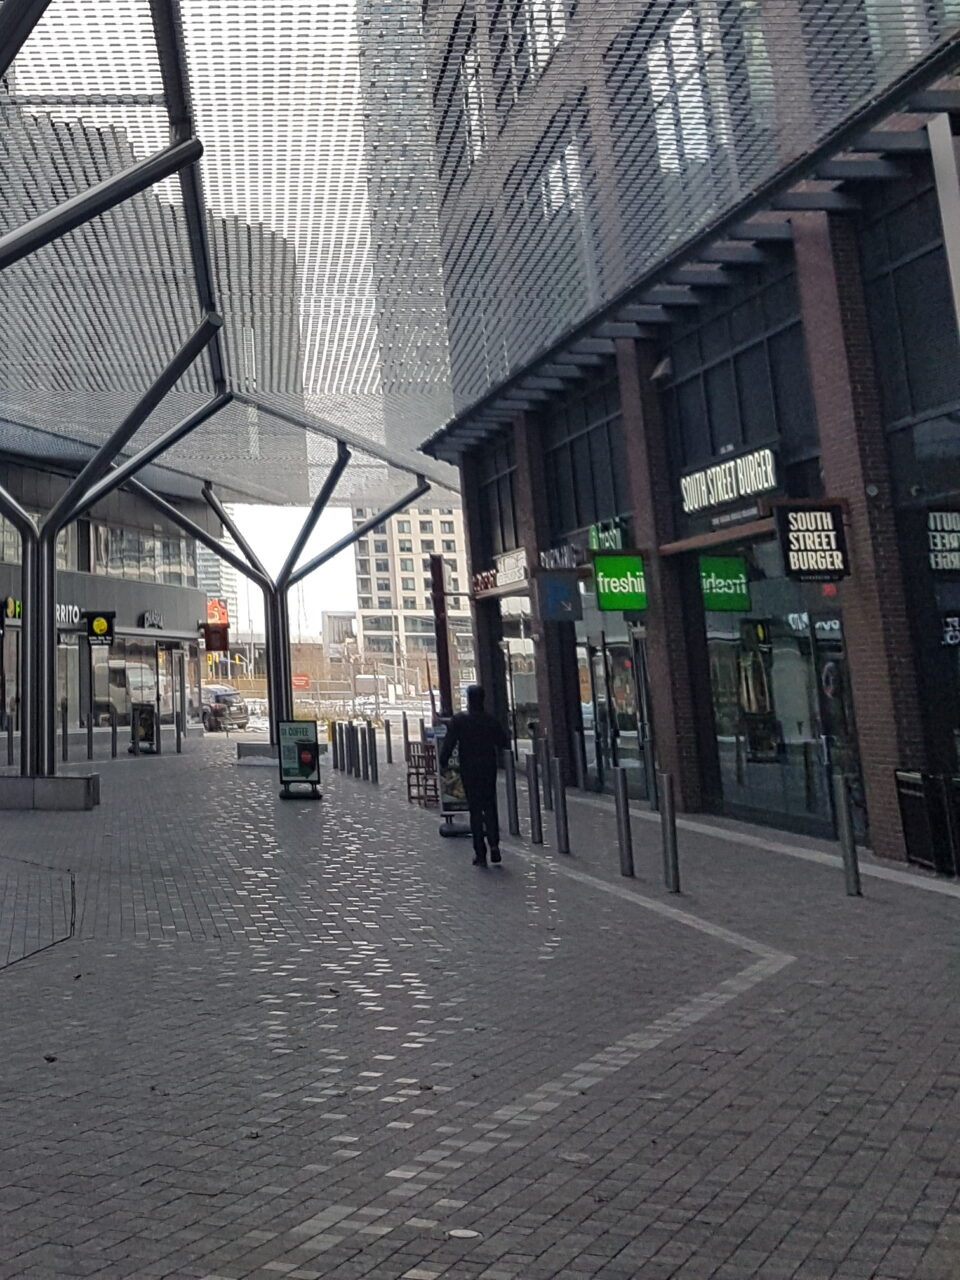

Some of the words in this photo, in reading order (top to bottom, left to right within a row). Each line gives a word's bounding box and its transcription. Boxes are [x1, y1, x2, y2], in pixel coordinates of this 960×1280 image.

[681, 471, 709, 512] SOUTH
[707, 460, 738, 505] STREET
[736, 449, 776, 495] BURGER
[789, 511, 833, 531] SOUTH
[789, 531, 836, 550] STREET
[790, 551, 844, 570] BURGER
[597, 572, 646, 593] freshii
